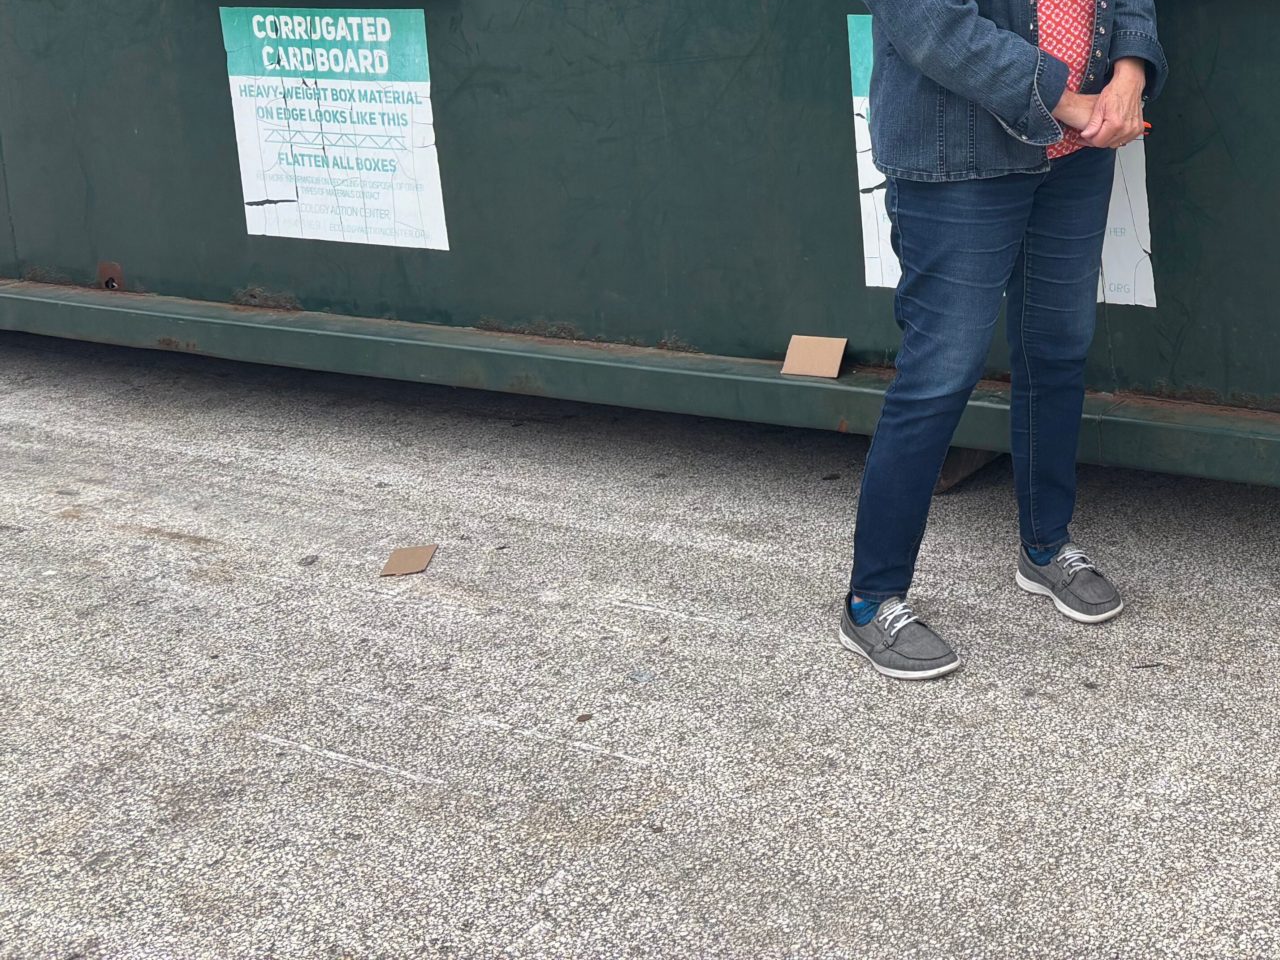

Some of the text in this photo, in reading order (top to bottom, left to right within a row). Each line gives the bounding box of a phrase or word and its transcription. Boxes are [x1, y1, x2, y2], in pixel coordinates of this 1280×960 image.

[252, 14, 392, 42] CORRUGATED
[262, 46, 389, 74] CARDBOARD
[239, 84, 422, 105] HEAVY-WEIGHT BOX MATERIAL
[257, 107, 408, 127] ON EDGE LOOKS LIKE THIS
[278, 152, 397, 173] FLATTEN ALL BOXES
[1109, 227, 1126, 237] HER
